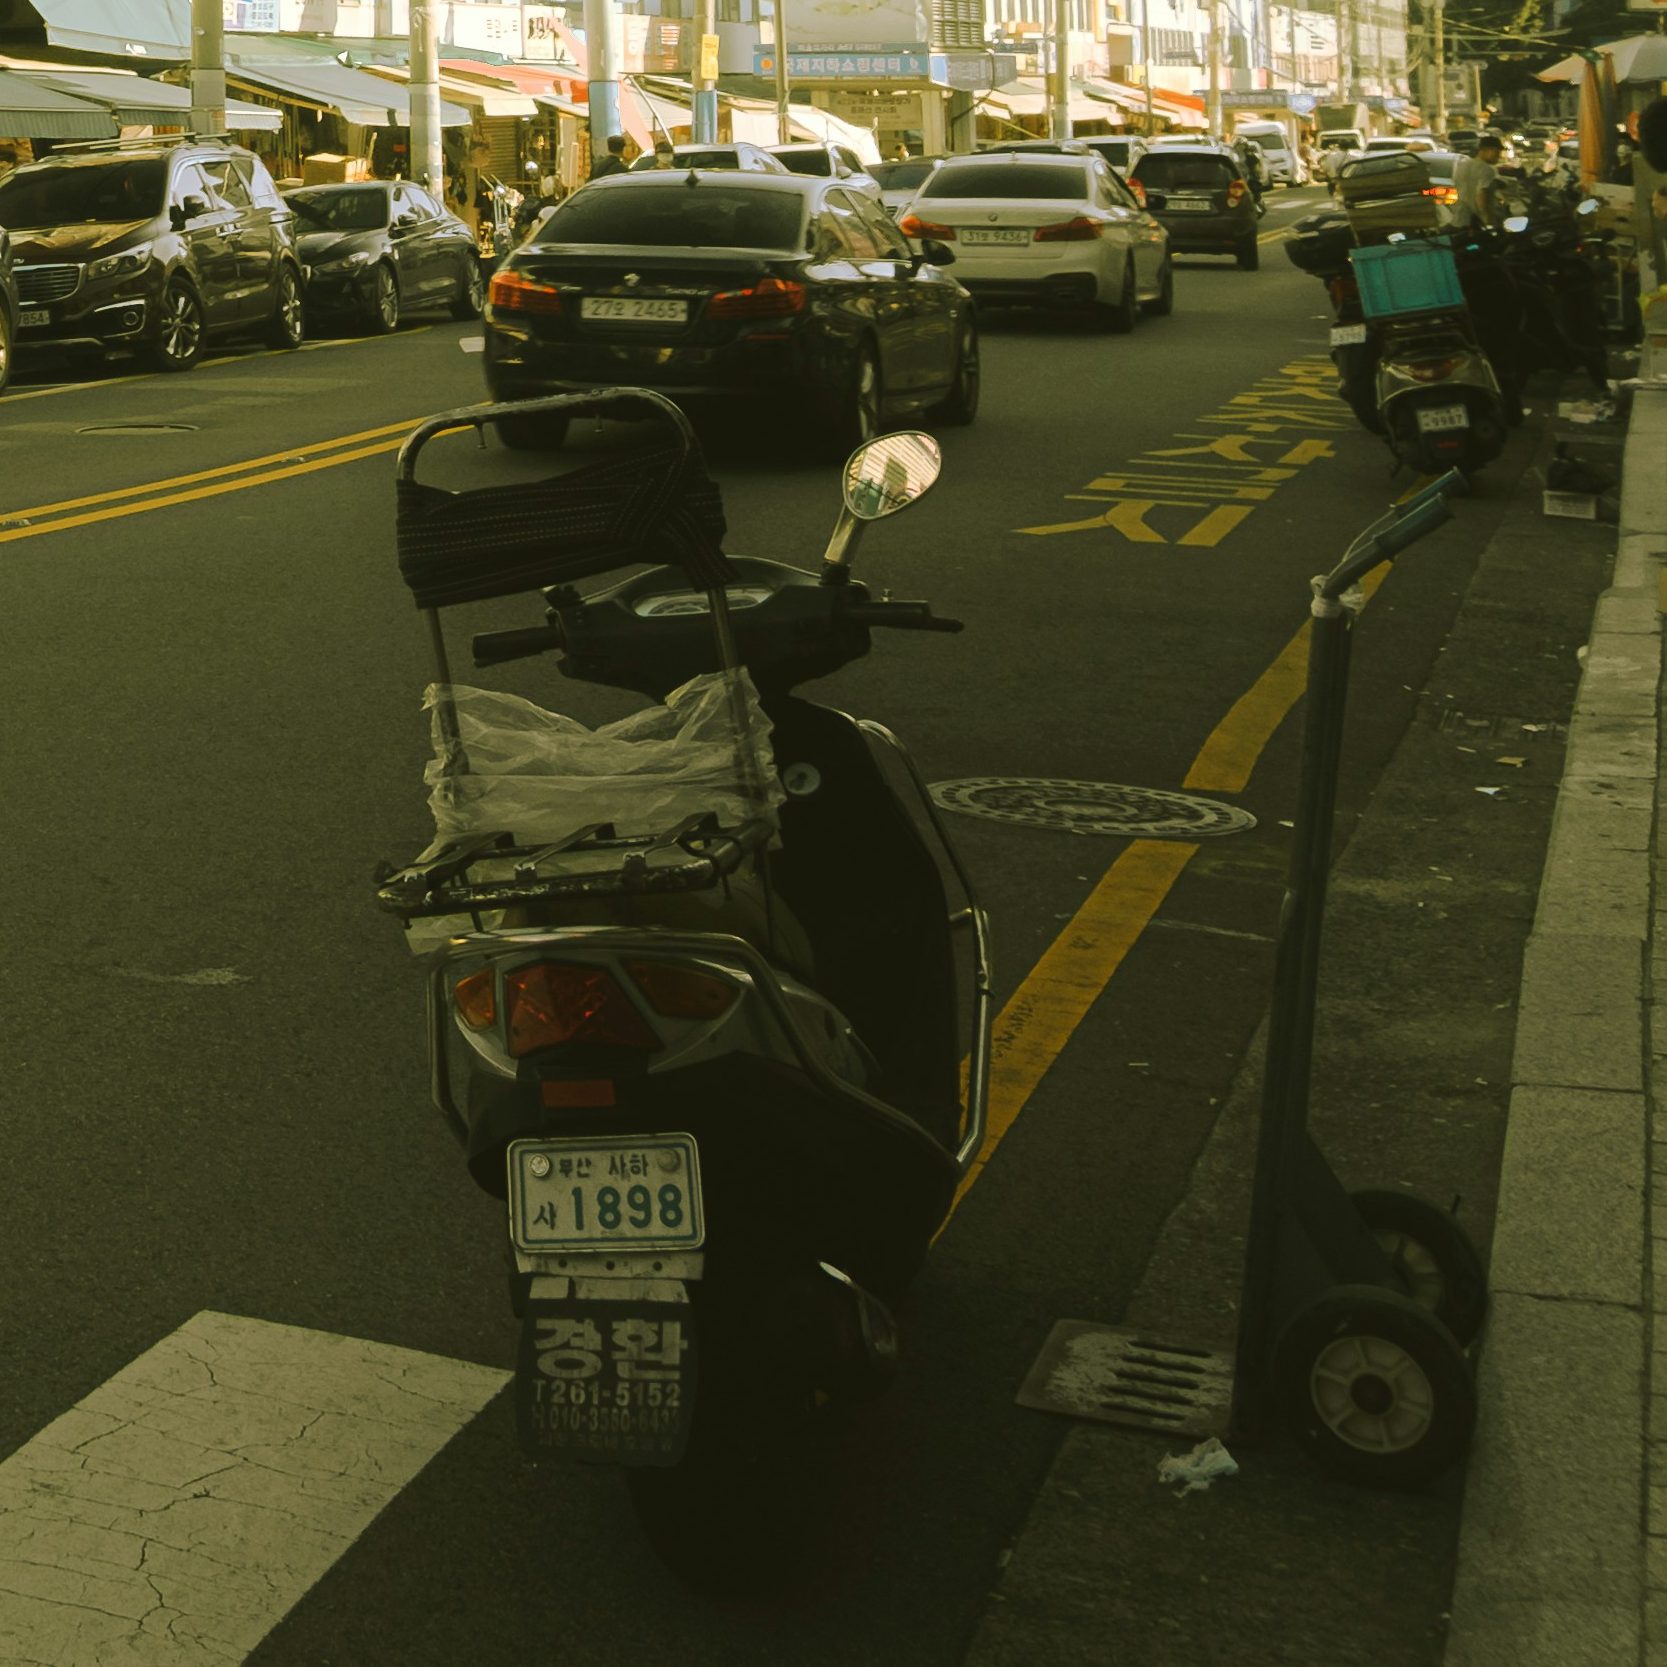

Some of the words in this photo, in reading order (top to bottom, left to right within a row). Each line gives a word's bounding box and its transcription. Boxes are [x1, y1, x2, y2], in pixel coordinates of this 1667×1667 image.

[634, 301, 678, 318] 2465
[559, 1159, 592, 1178] 부산
[608, 1154, 648, 1179] 사하
[533, 1202, 558, 1230] 사
[571, 1183, 683, 1231] 1898
[535, 1318, 689, 1379] 경환
[550, 1380, 681, 1407] 261-5152
